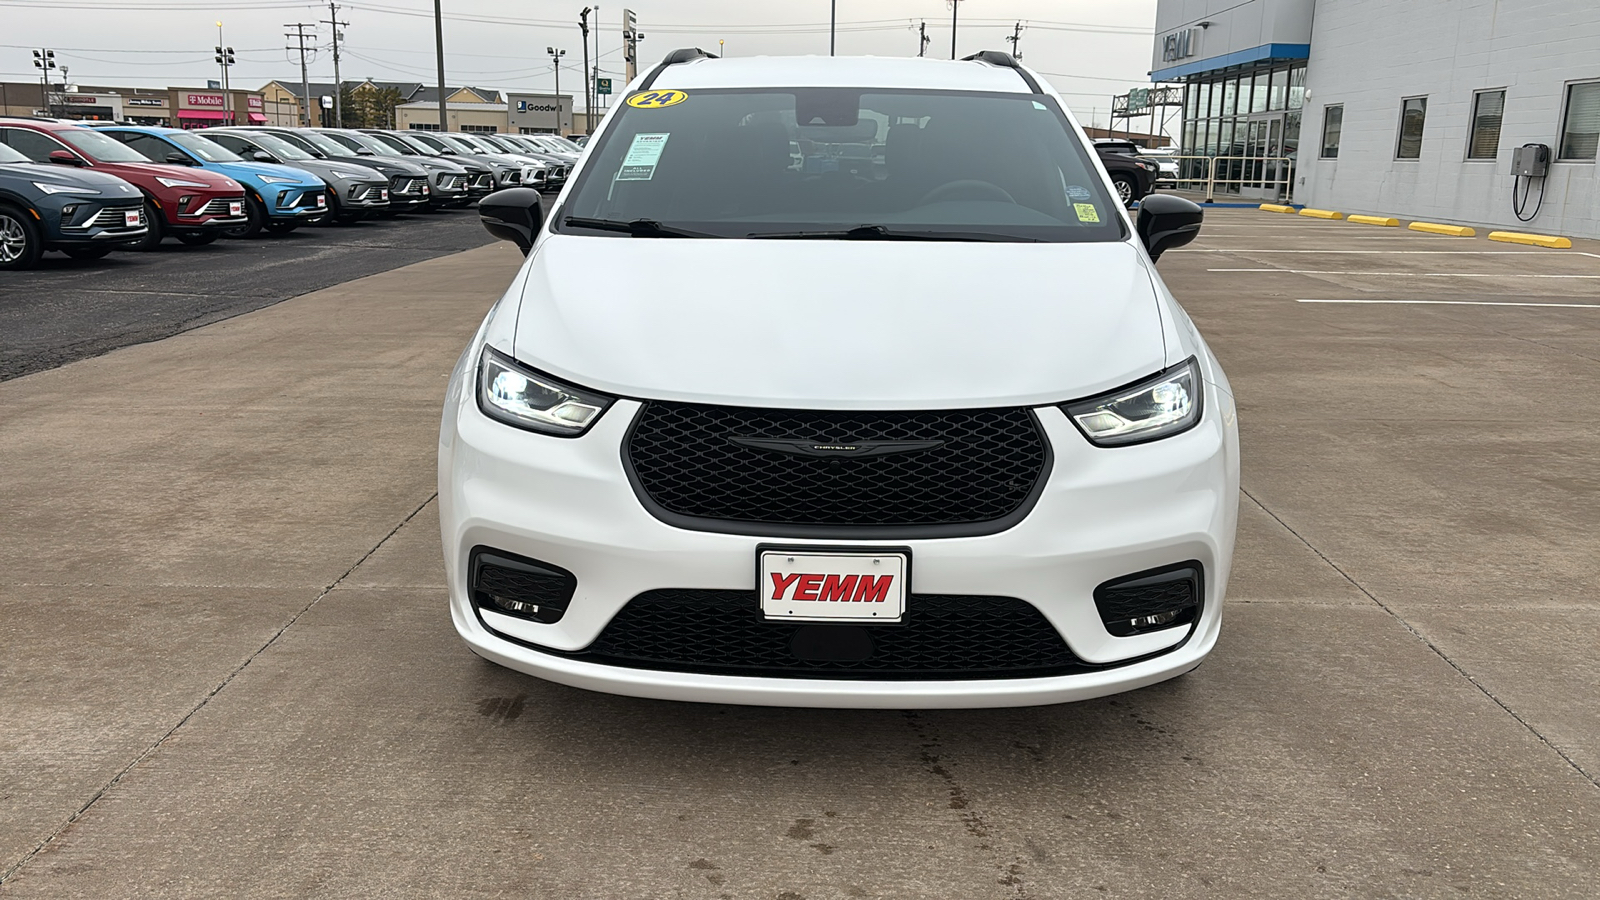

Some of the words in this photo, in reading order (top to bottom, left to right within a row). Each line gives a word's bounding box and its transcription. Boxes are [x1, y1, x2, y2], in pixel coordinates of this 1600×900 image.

[197, 96, 222, 105] Mobile
[637, 92, 675, 106] 24
[527, 103, 563, 112] Goodwl
[770, 572, 894, 603] YEMM
